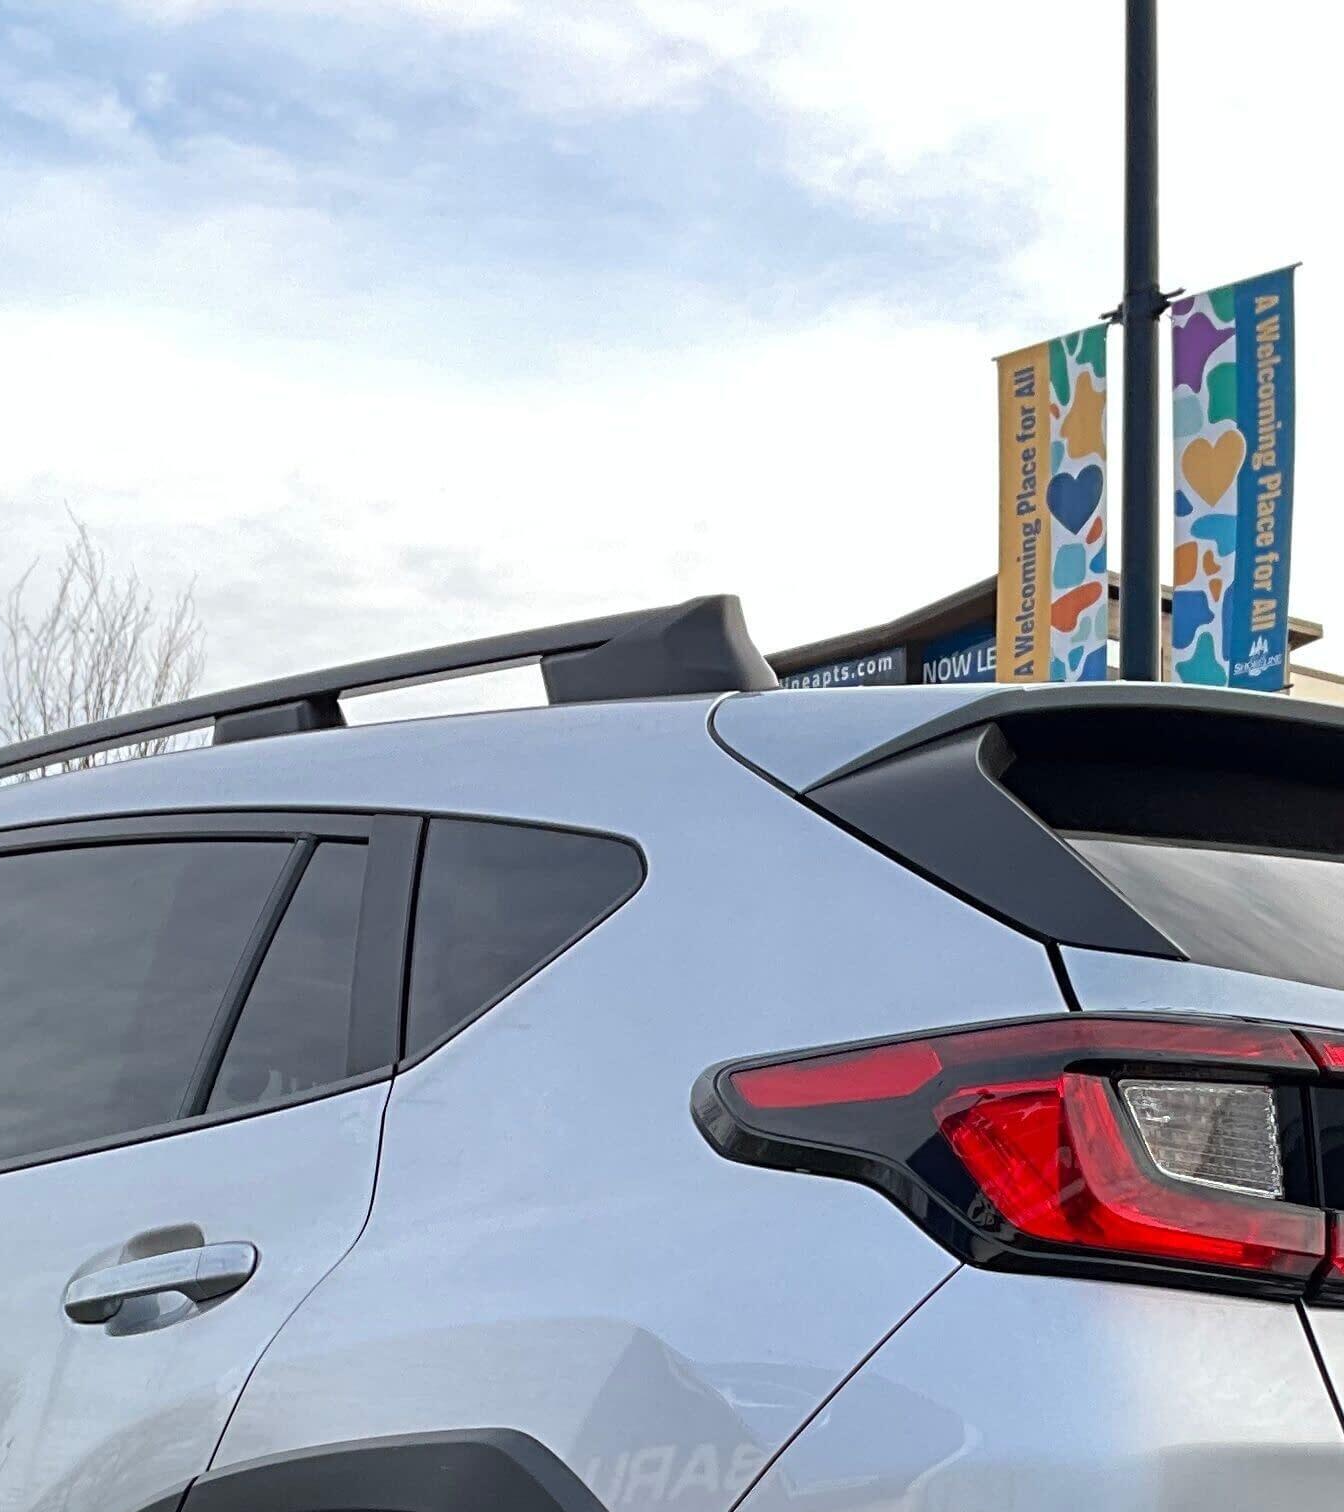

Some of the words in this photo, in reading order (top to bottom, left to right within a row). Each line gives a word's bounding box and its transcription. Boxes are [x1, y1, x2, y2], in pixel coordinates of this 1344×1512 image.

[1254, 295, 1280, 314] A
[1014, 366, 1036, 398] All
[1252, 314, 1282, 471] Welcoming
[1016, 405, 1037, 443] for
[1016, 447, 1037, 516] Place
[1255, 472, 1282, 547] Place
[1014, 518, 1042, 659] Welcoming
[1253, 551, 1280, 591] for
[1251, 599, 1277, 632] All
[922, 653, 972, 684] NOW
[1013, 659, 1035, 676] A
